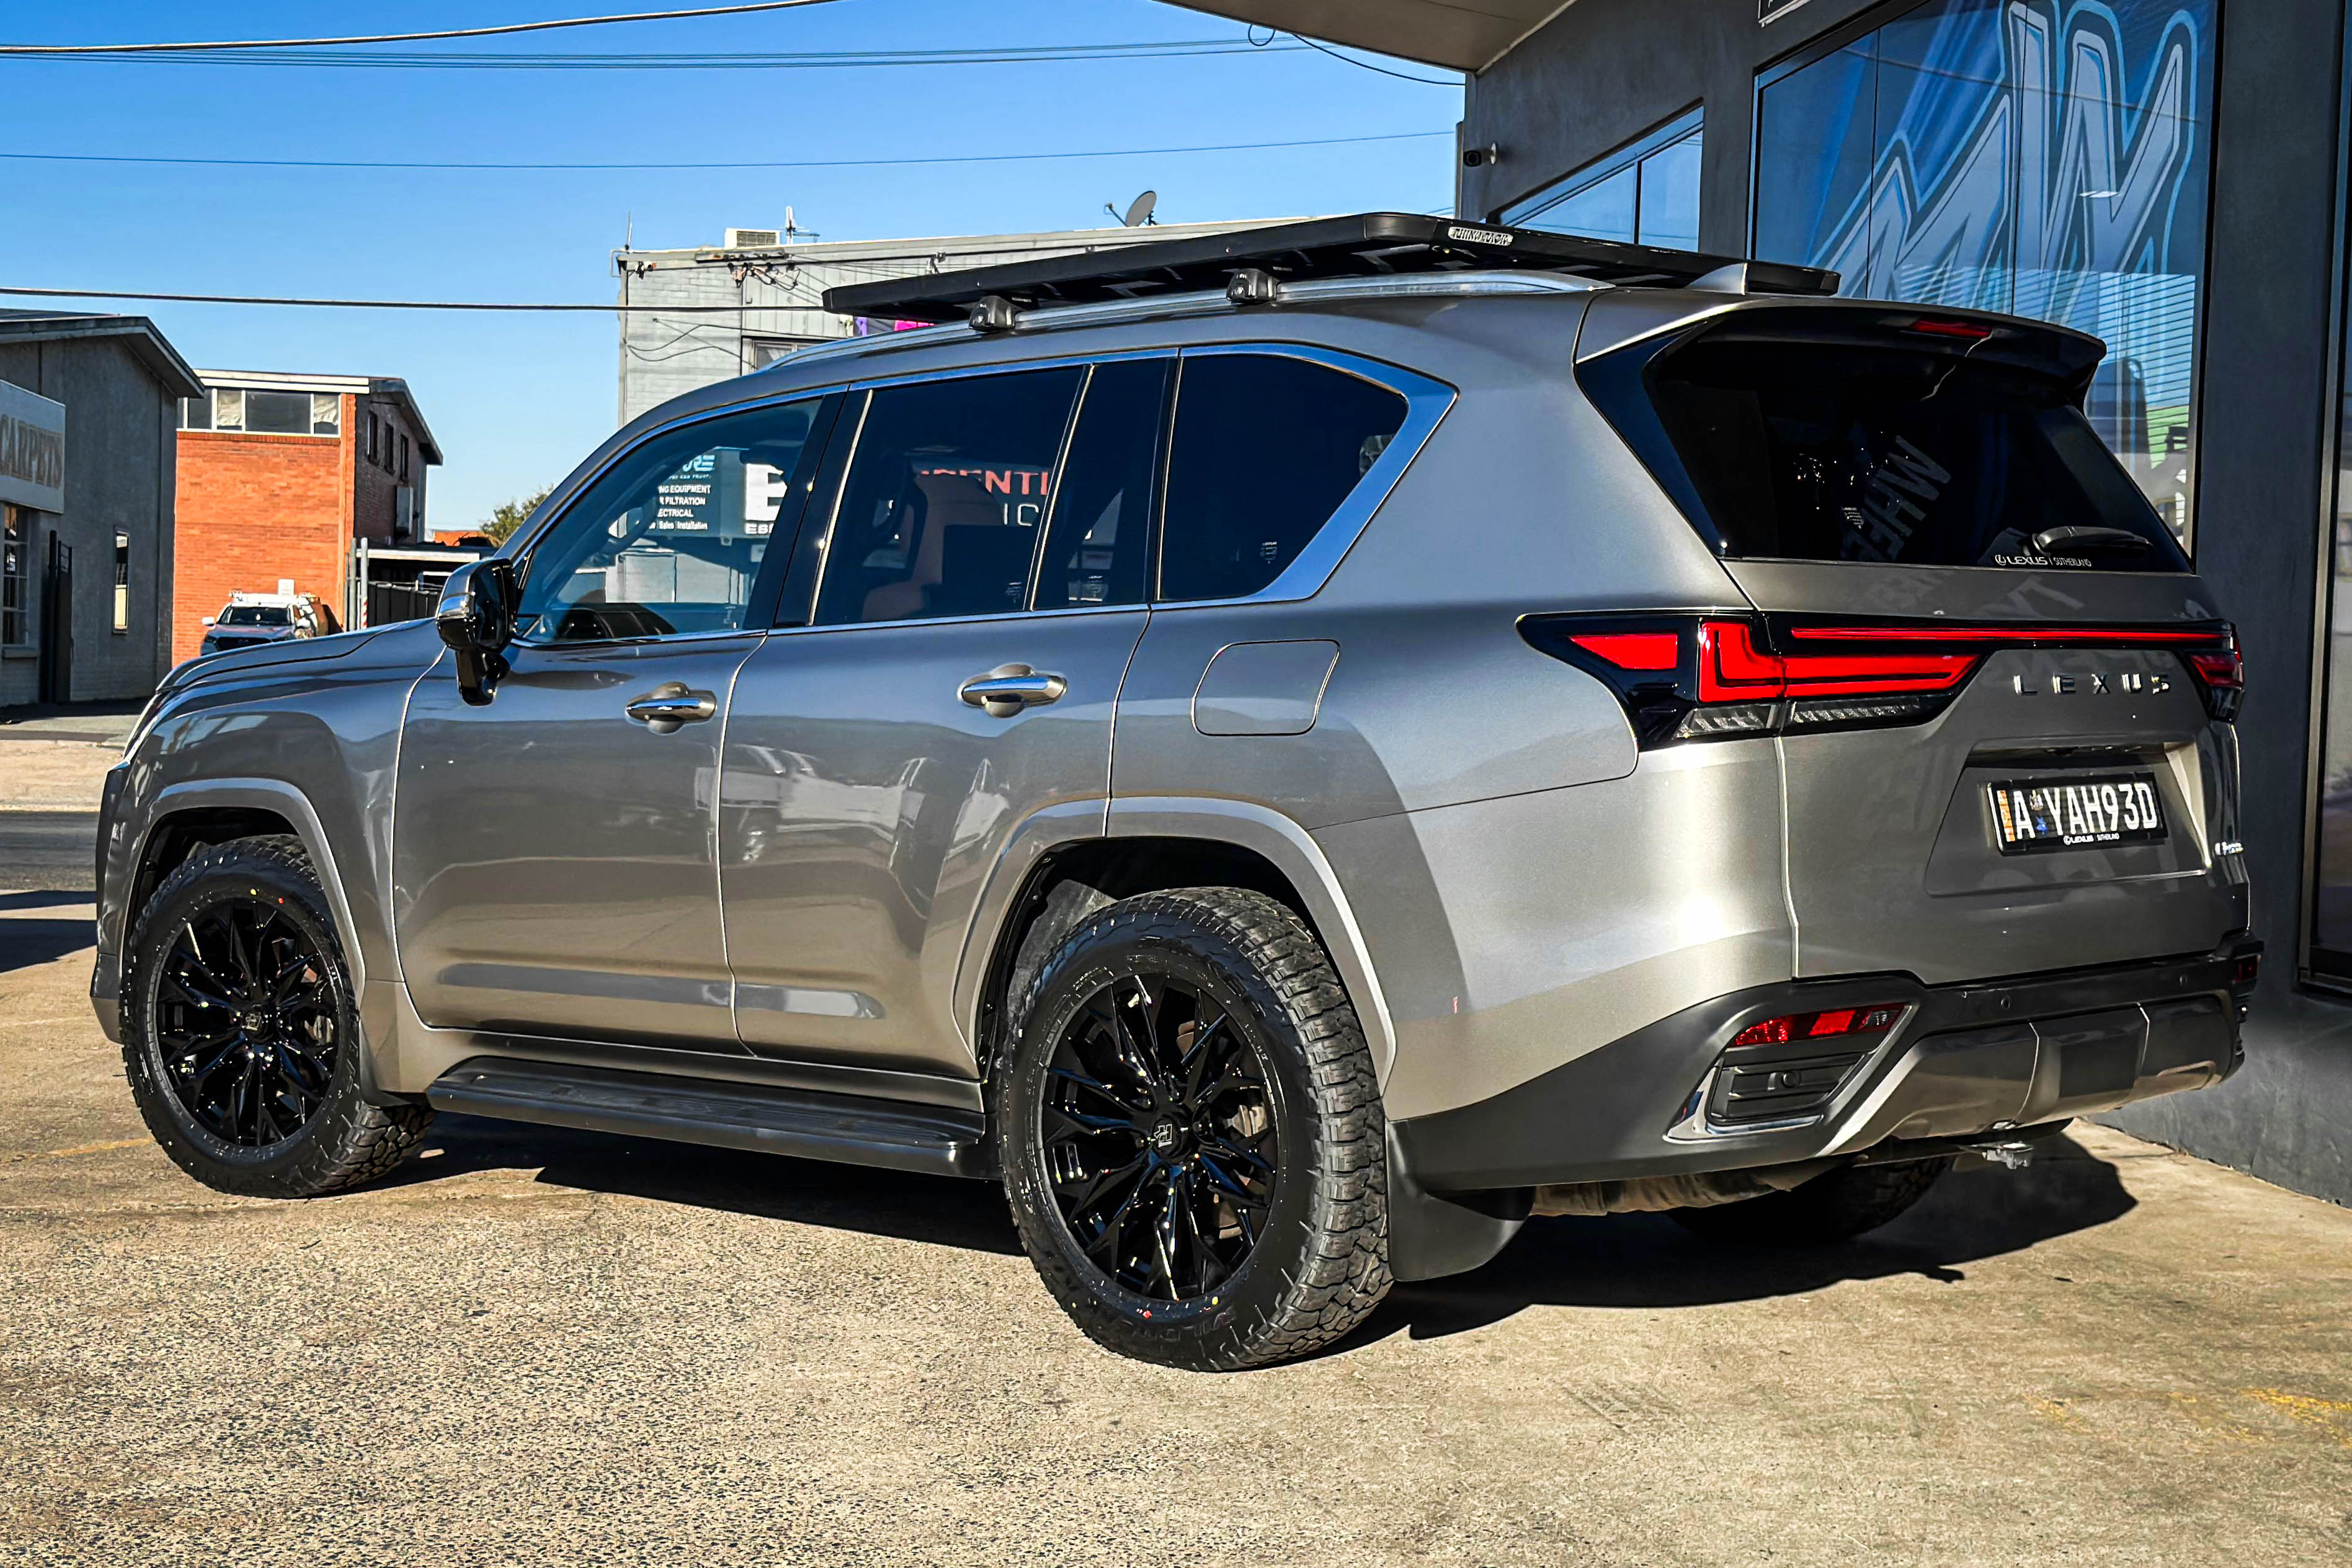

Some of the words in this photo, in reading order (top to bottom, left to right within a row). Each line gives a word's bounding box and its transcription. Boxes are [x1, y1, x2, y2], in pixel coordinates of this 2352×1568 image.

[670, 484, 711, 494] EQUIPMENT
[665, 497, 706, 506] FILTRATION
[677, 520, 708, 530] Installation
[2007, 556, 2048, 565] LEXUS
[2013, 672, 2170, 695] LEXUS
